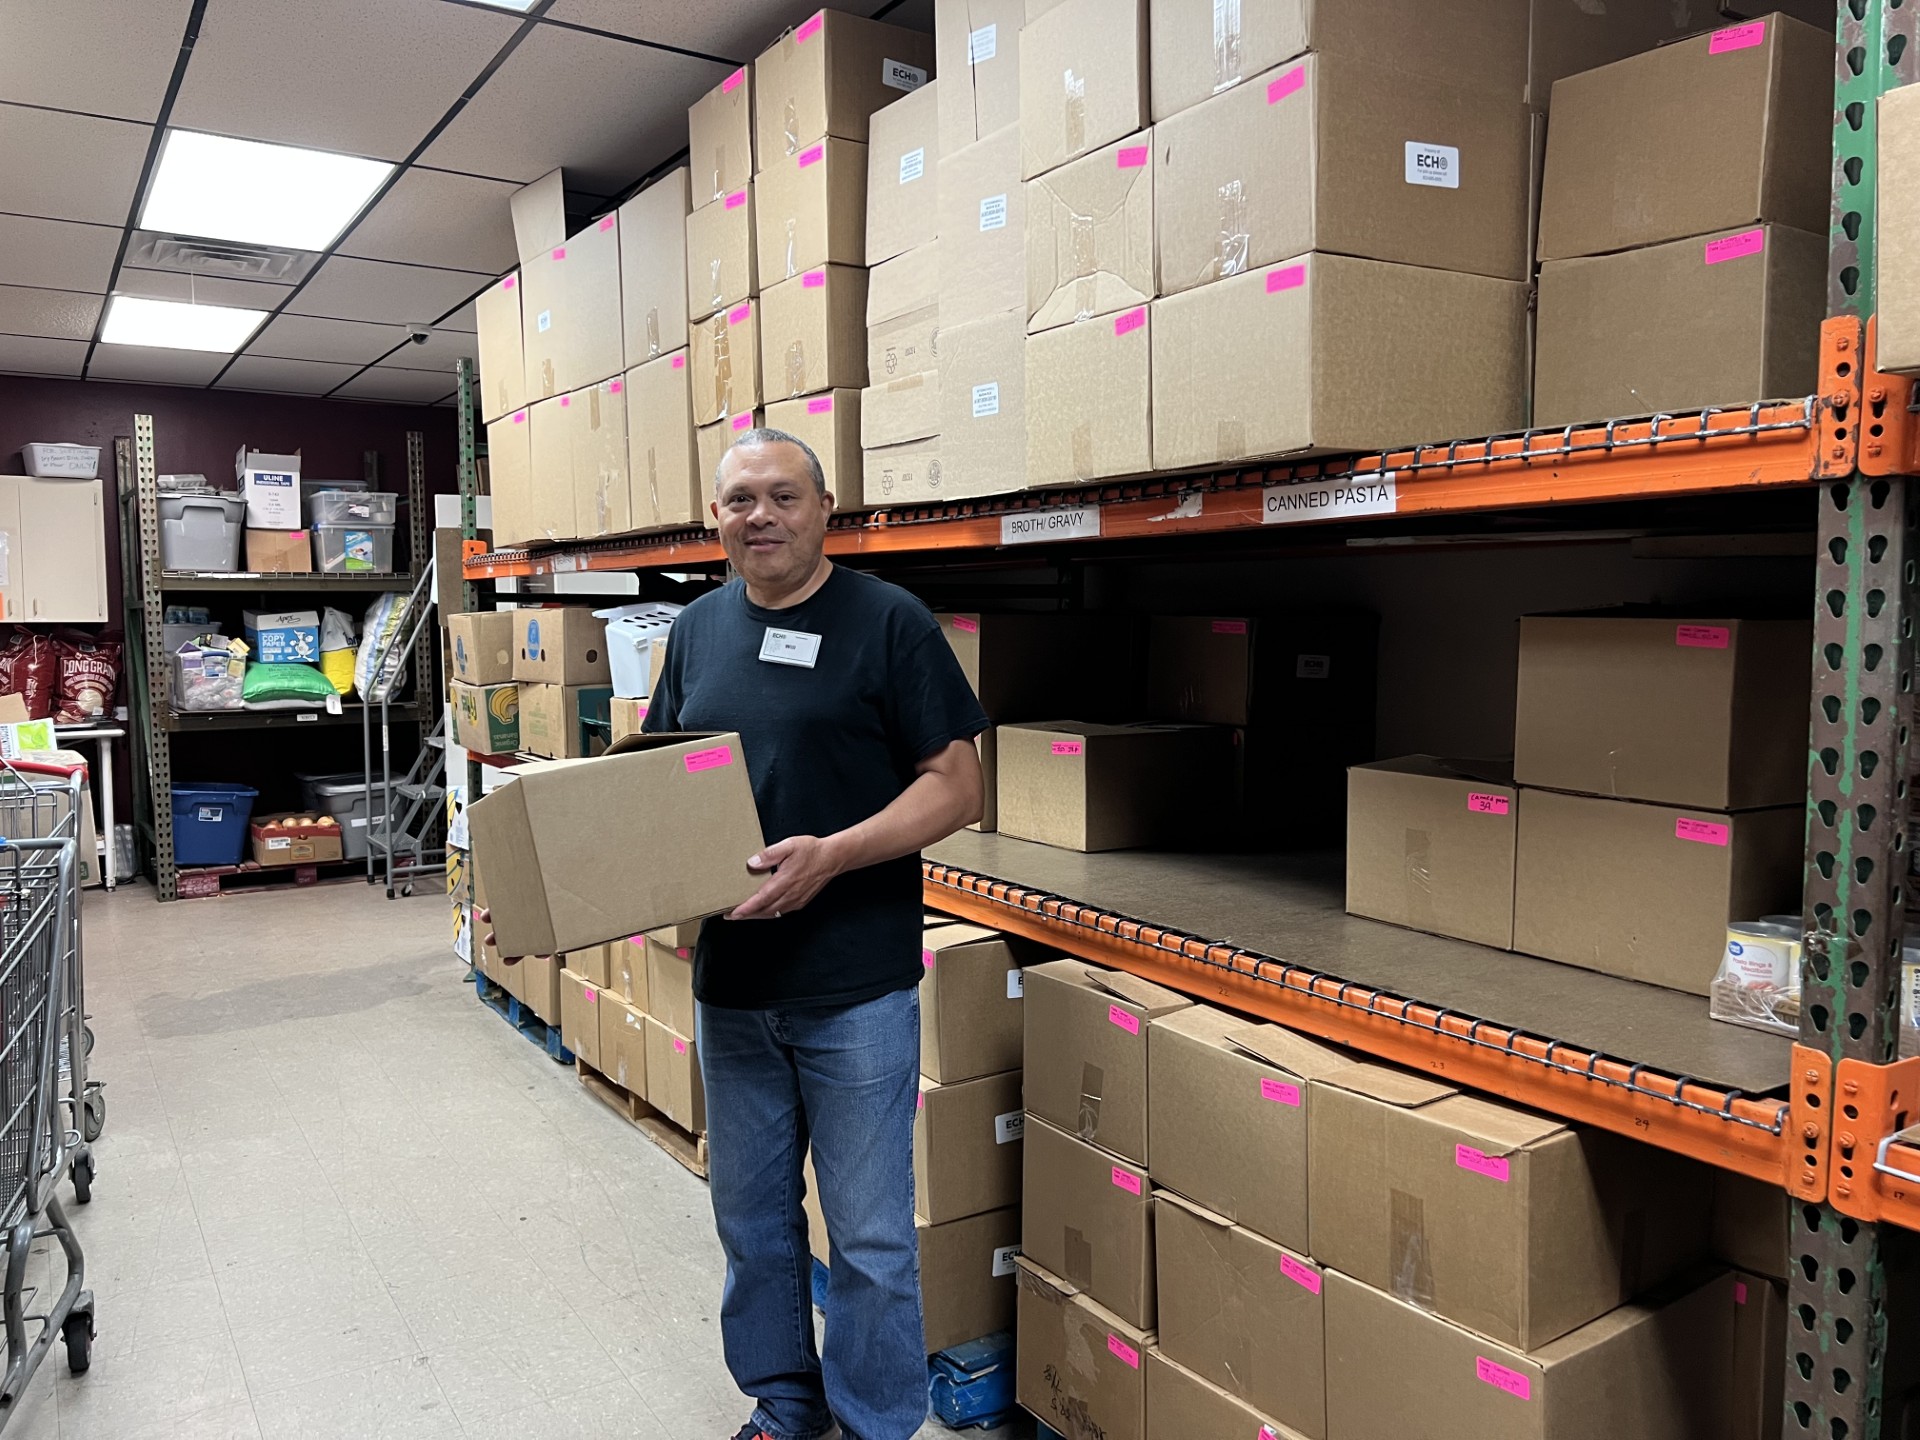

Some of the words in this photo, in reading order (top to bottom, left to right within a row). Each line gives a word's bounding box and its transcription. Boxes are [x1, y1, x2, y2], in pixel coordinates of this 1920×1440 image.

[1416, 153, 1448, 170] ECHO
[263, 474, 284, 482] ULINE
[1267, 491, 1330, 512] CANNED
[1334, 484, 1389, 506] PASTA
[1011, 517, 1046, 534] BROTH/
[1048, 511, 1084, 529] GRAVY
[64, 659, 90, 677] LONG
[1429, 1060, 1445, 1070] 23
[1006, 1116, 1024, 1130] ECH
[1002, 1250, 1022, 1262] ECH
